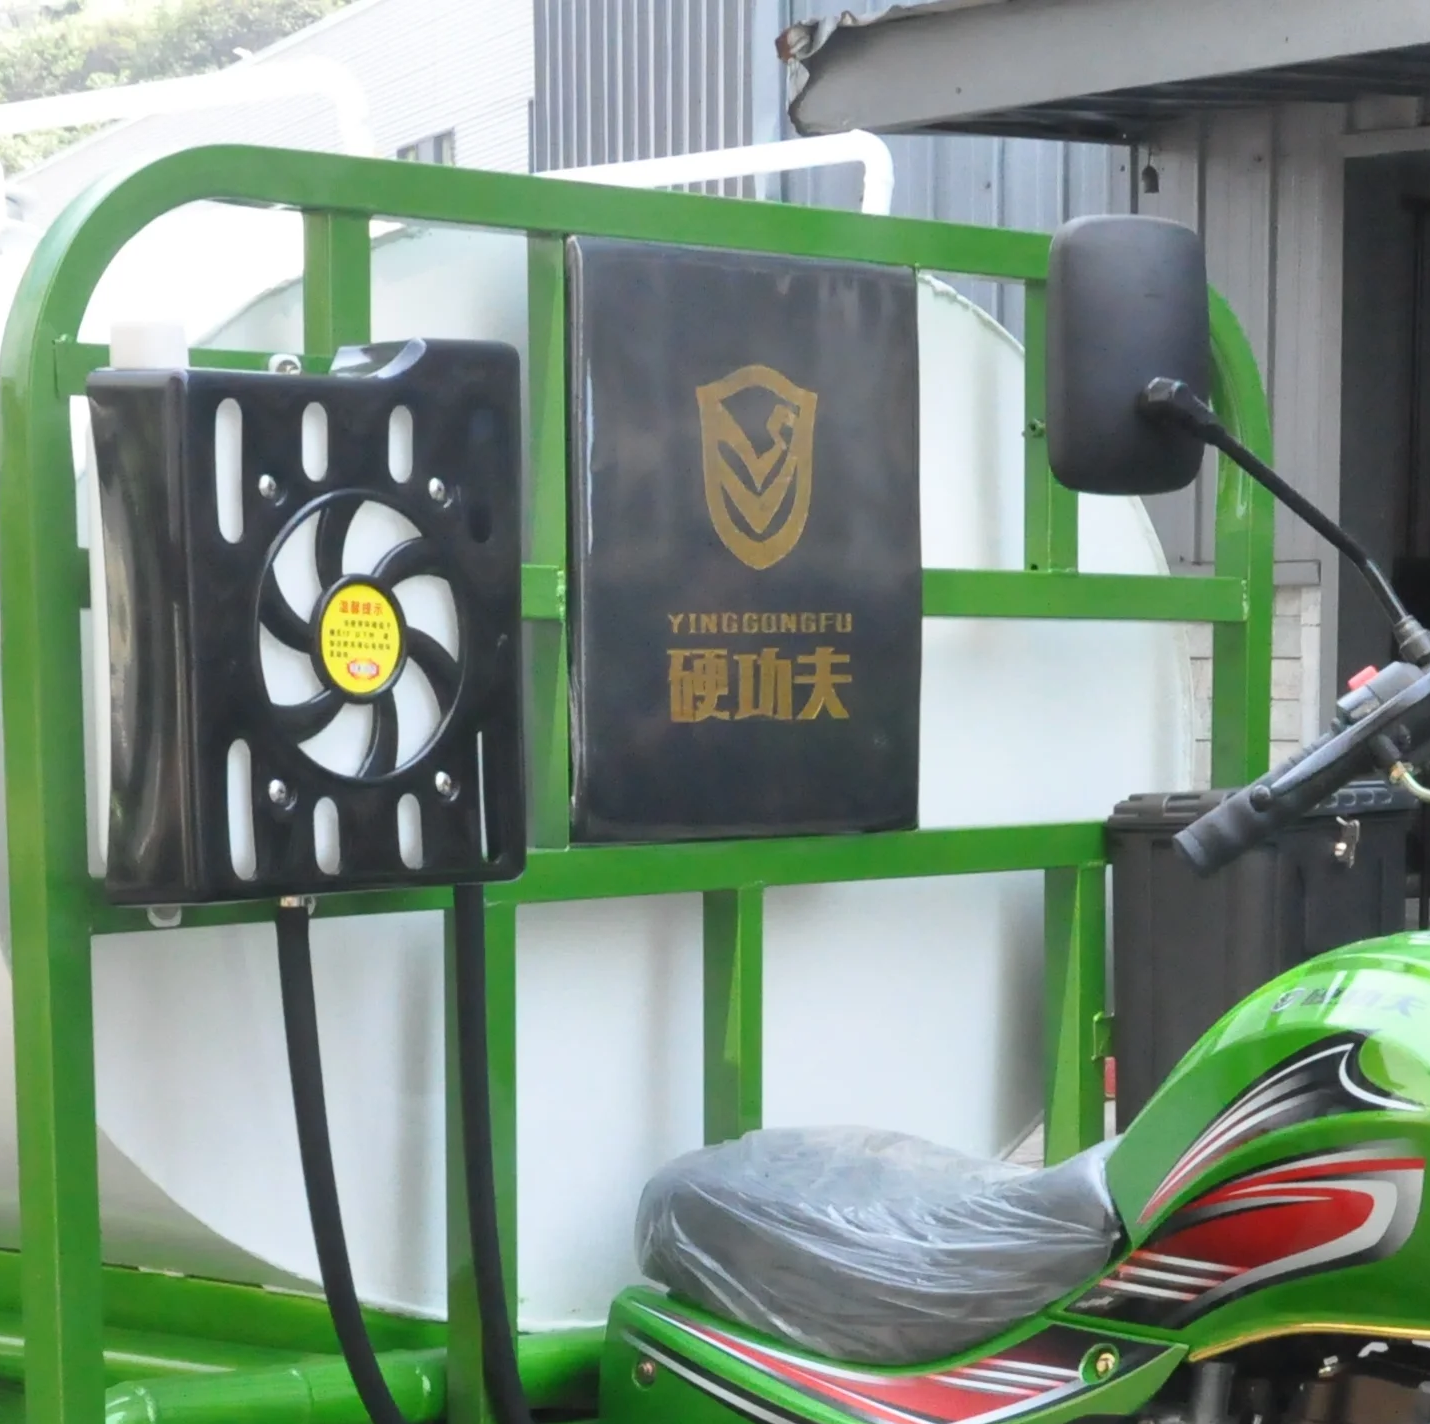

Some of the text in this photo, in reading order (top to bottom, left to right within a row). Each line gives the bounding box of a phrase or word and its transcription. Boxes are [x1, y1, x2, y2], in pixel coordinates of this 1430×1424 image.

[668, 612, 853, 634] YINGGONGFU
[667, 647, 853, 722] 硬功夫
